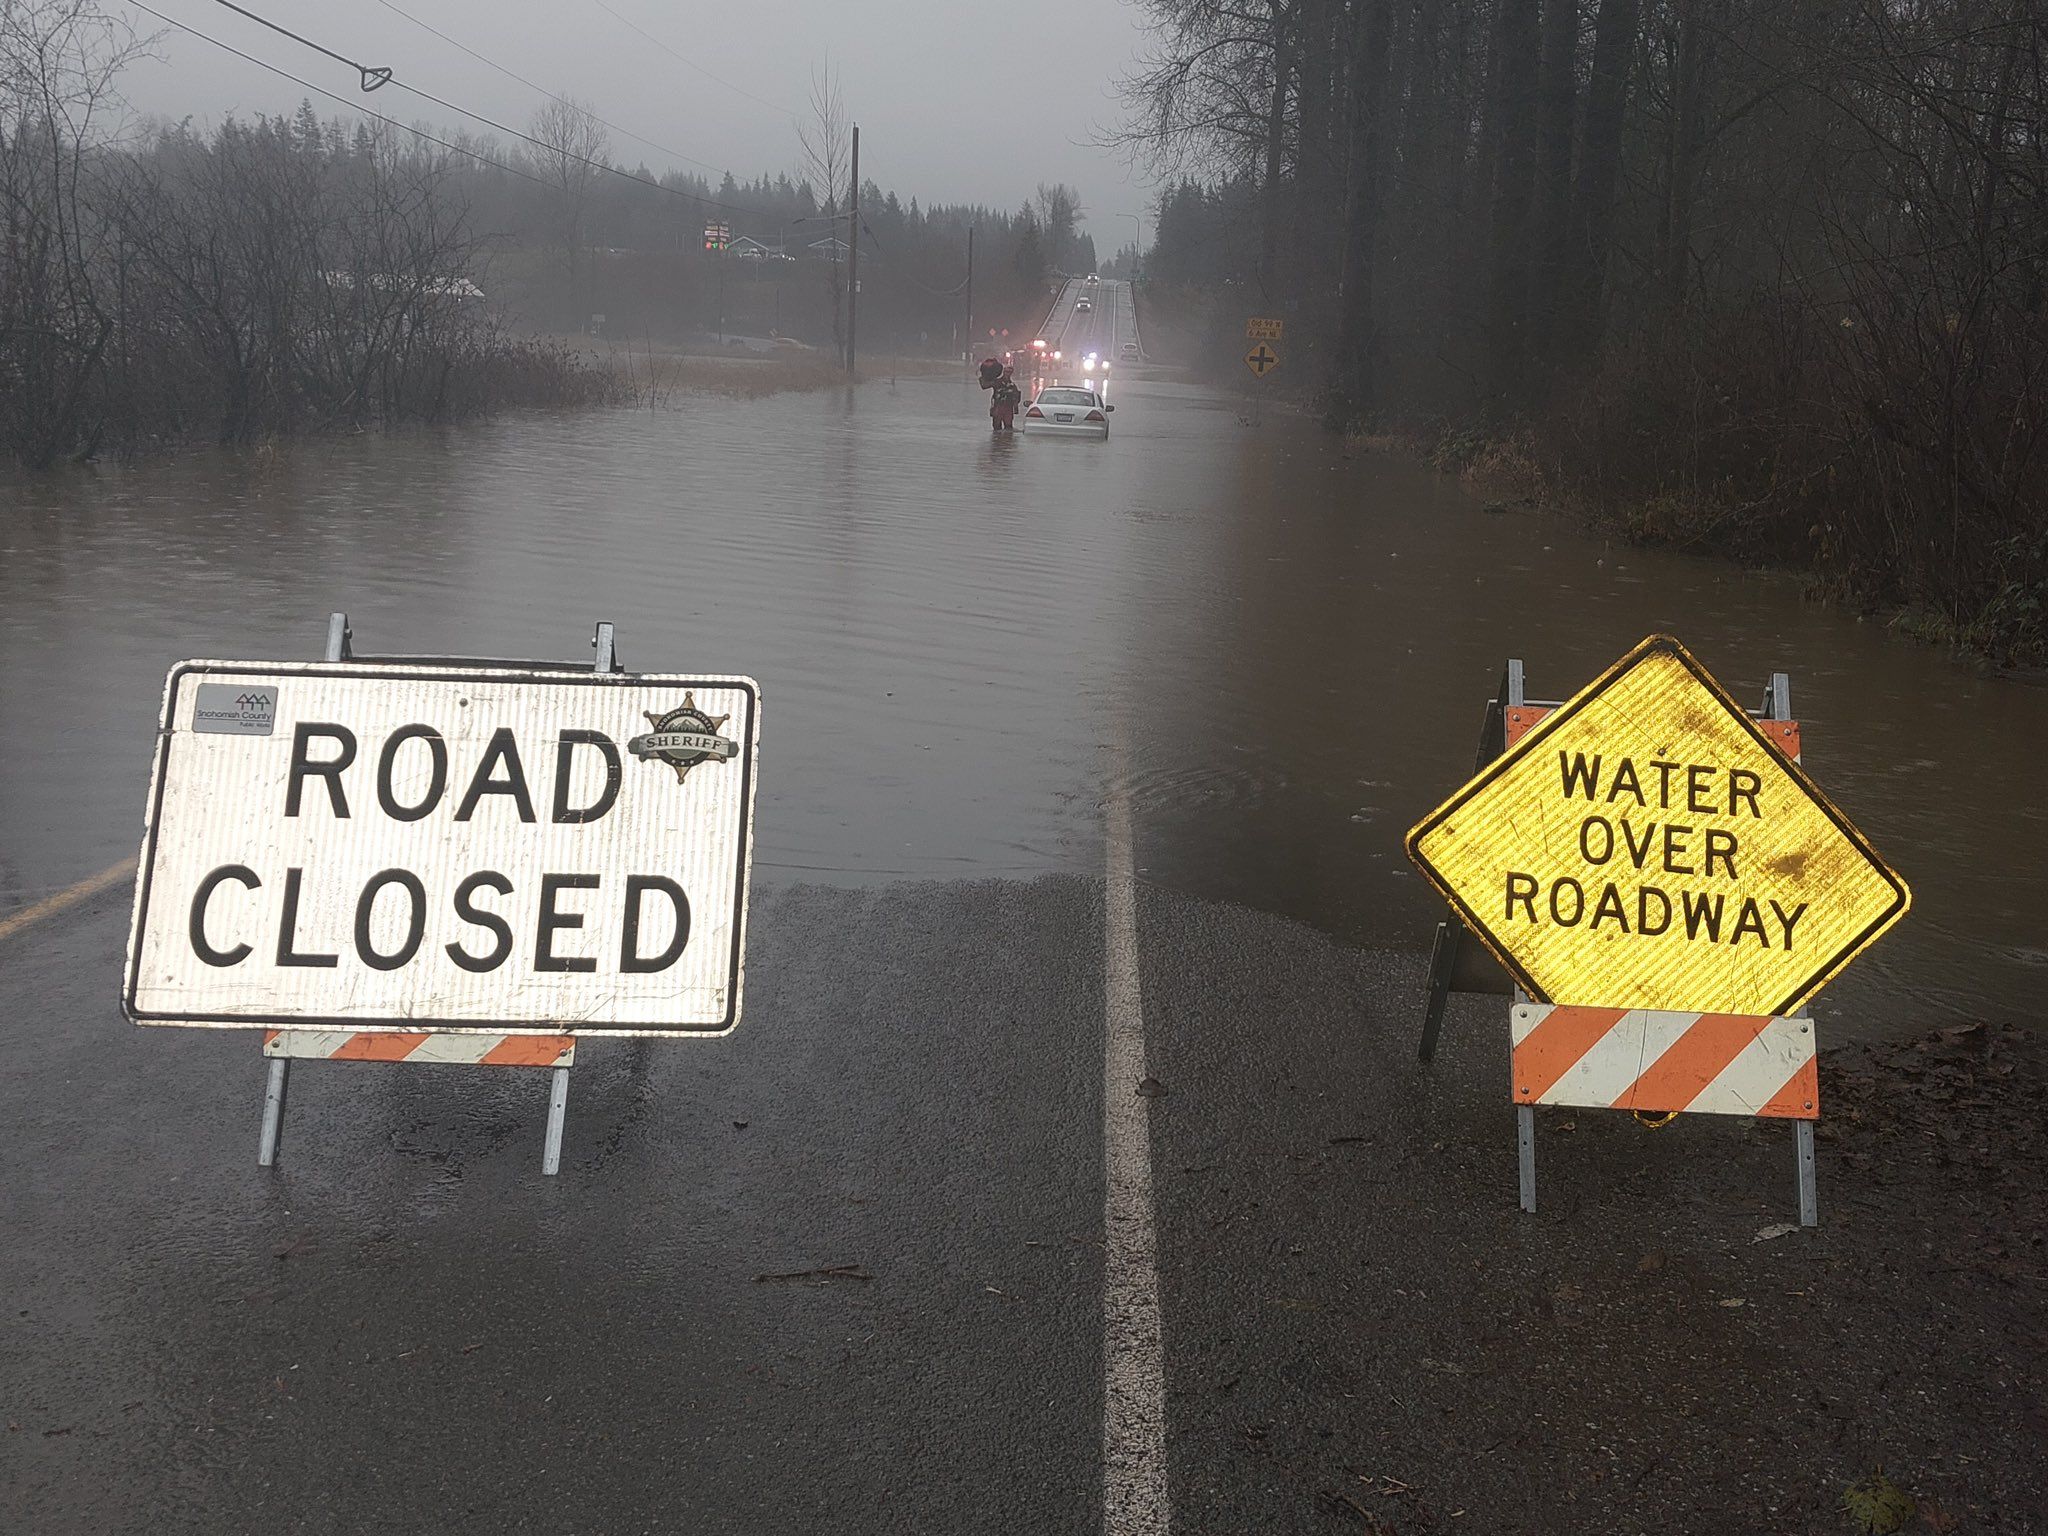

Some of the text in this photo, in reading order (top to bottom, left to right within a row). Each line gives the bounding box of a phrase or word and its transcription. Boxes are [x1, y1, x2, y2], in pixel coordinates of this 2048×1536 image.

[197, 709, 272, 721] Snohomish County
[646, 735, 722, 750] SHERIFF
[284, 722, 623, 824] ROAD
[1558, 749, 1763, 819] WATER
[1579, 816, 1739, 880] OVER
[189, 864, 691, 974] CLOSED
[1505, 871, 1809, 951] ROADWAY
